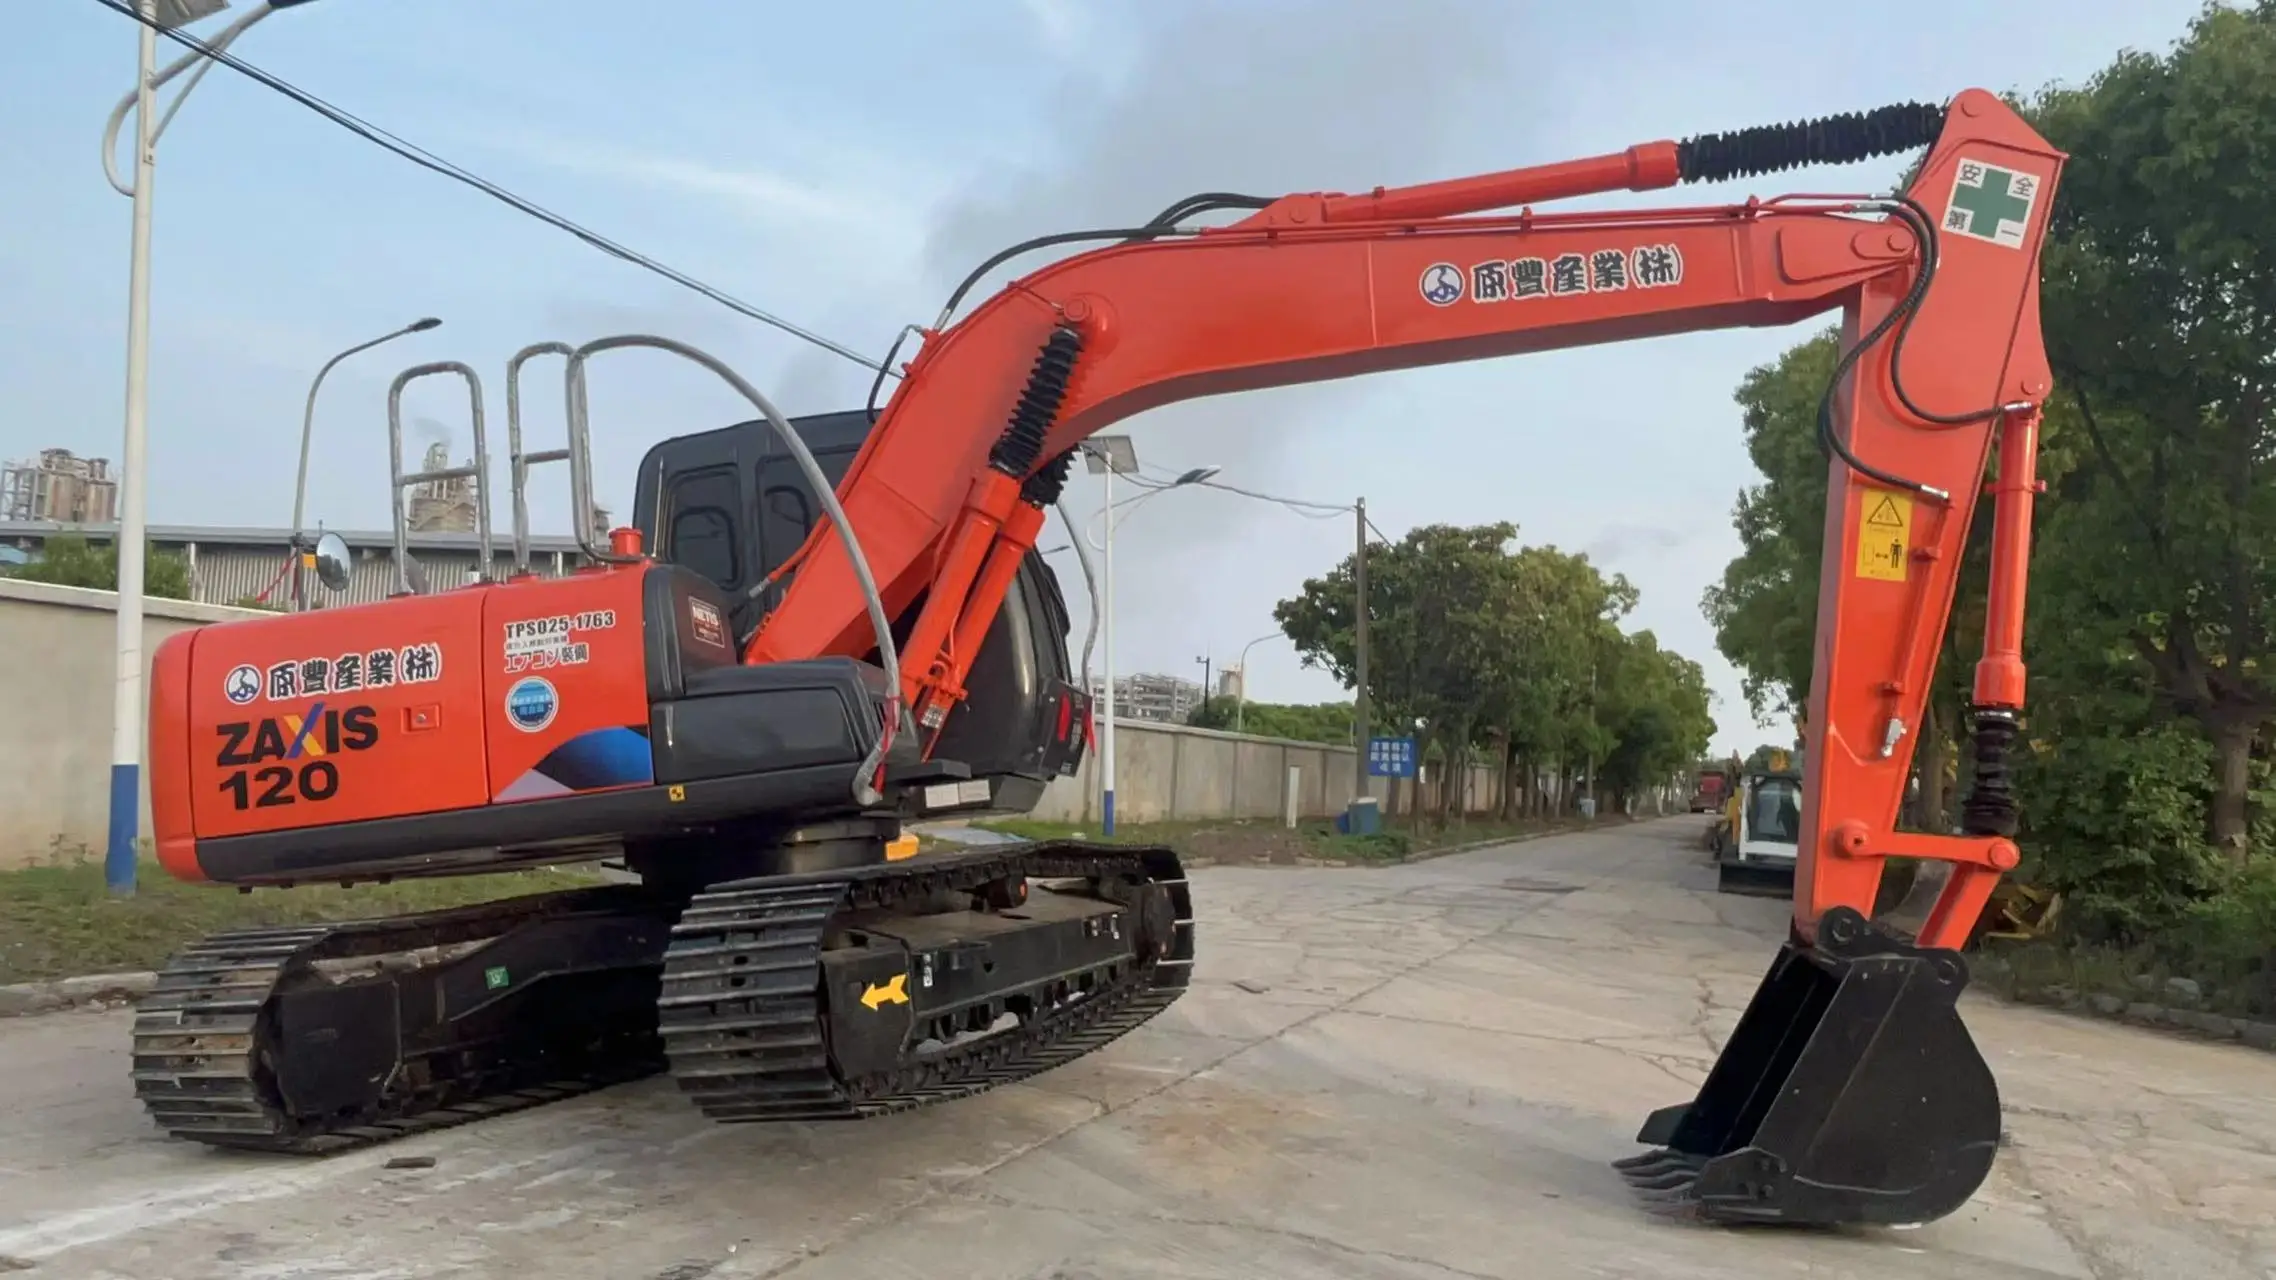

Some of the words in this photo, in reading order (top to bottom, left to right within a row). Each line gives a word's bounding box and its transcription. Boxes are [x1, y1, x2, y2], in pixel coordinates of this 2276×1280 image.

[505, 611, 615, 639] TPS025-1763
[216, 701, 379, 767] ZAXIS
[219, 760, 339, 811] 120
